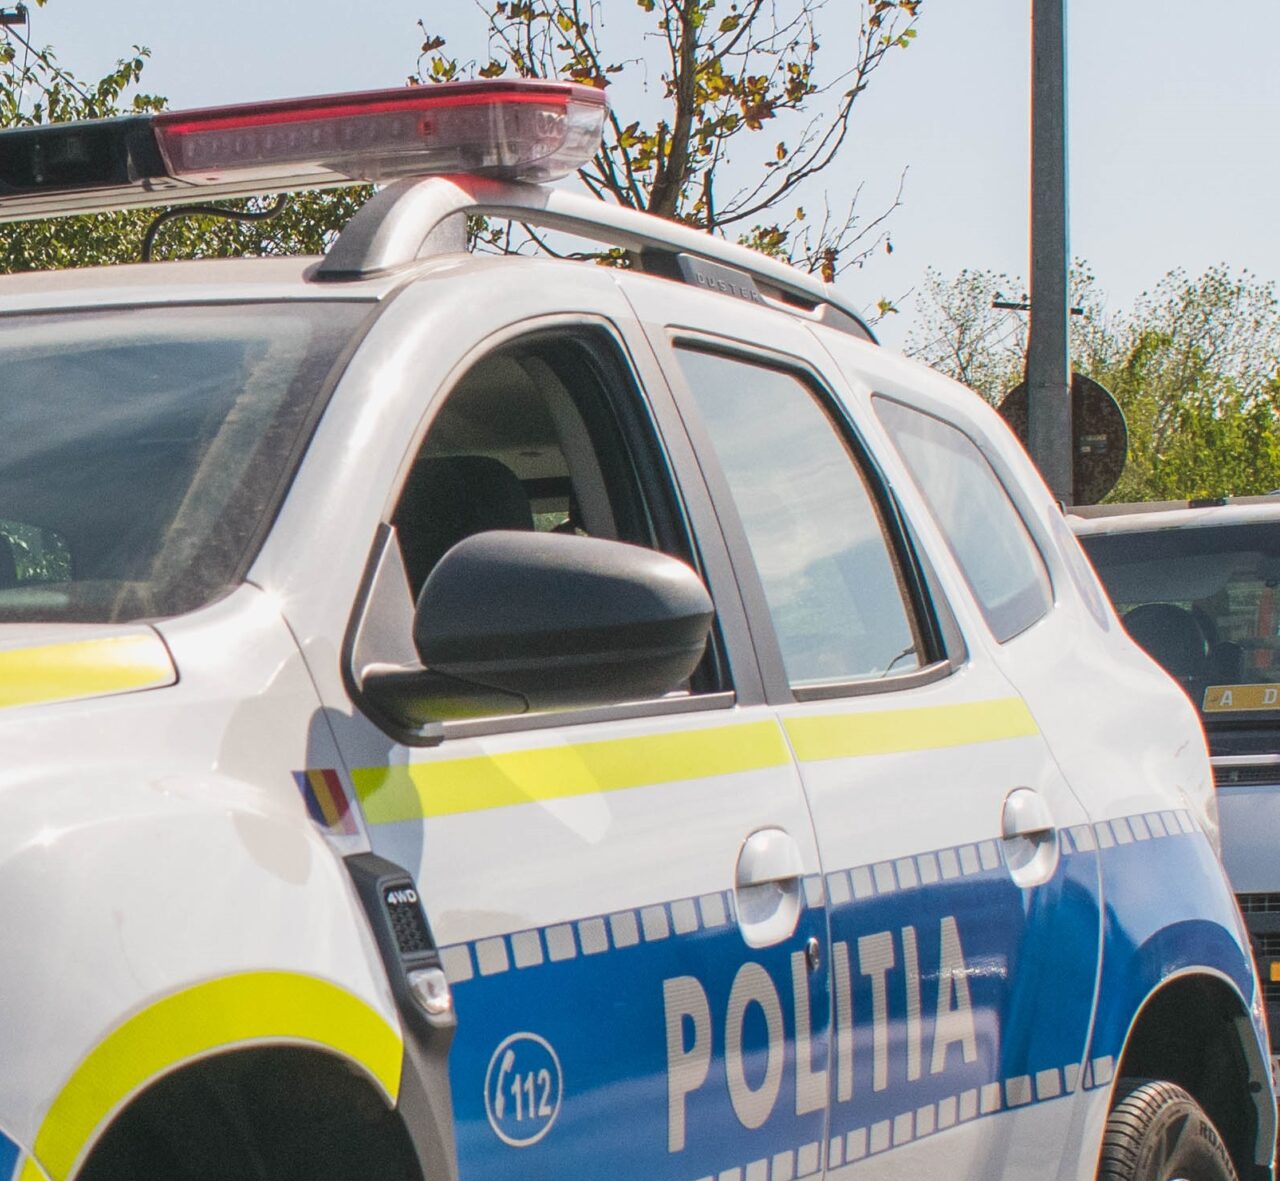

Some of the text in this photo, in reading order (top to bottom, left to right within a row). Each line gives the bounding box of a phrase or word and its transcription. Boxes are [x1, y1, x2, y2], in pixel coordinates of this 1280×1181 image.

[696, 272, 760, 302] DUSTER
[387, 889, 417, 904] 4WD
[663, 916, 978, 1153] POLITIA
[511, 1068, 552, 1121] 112
